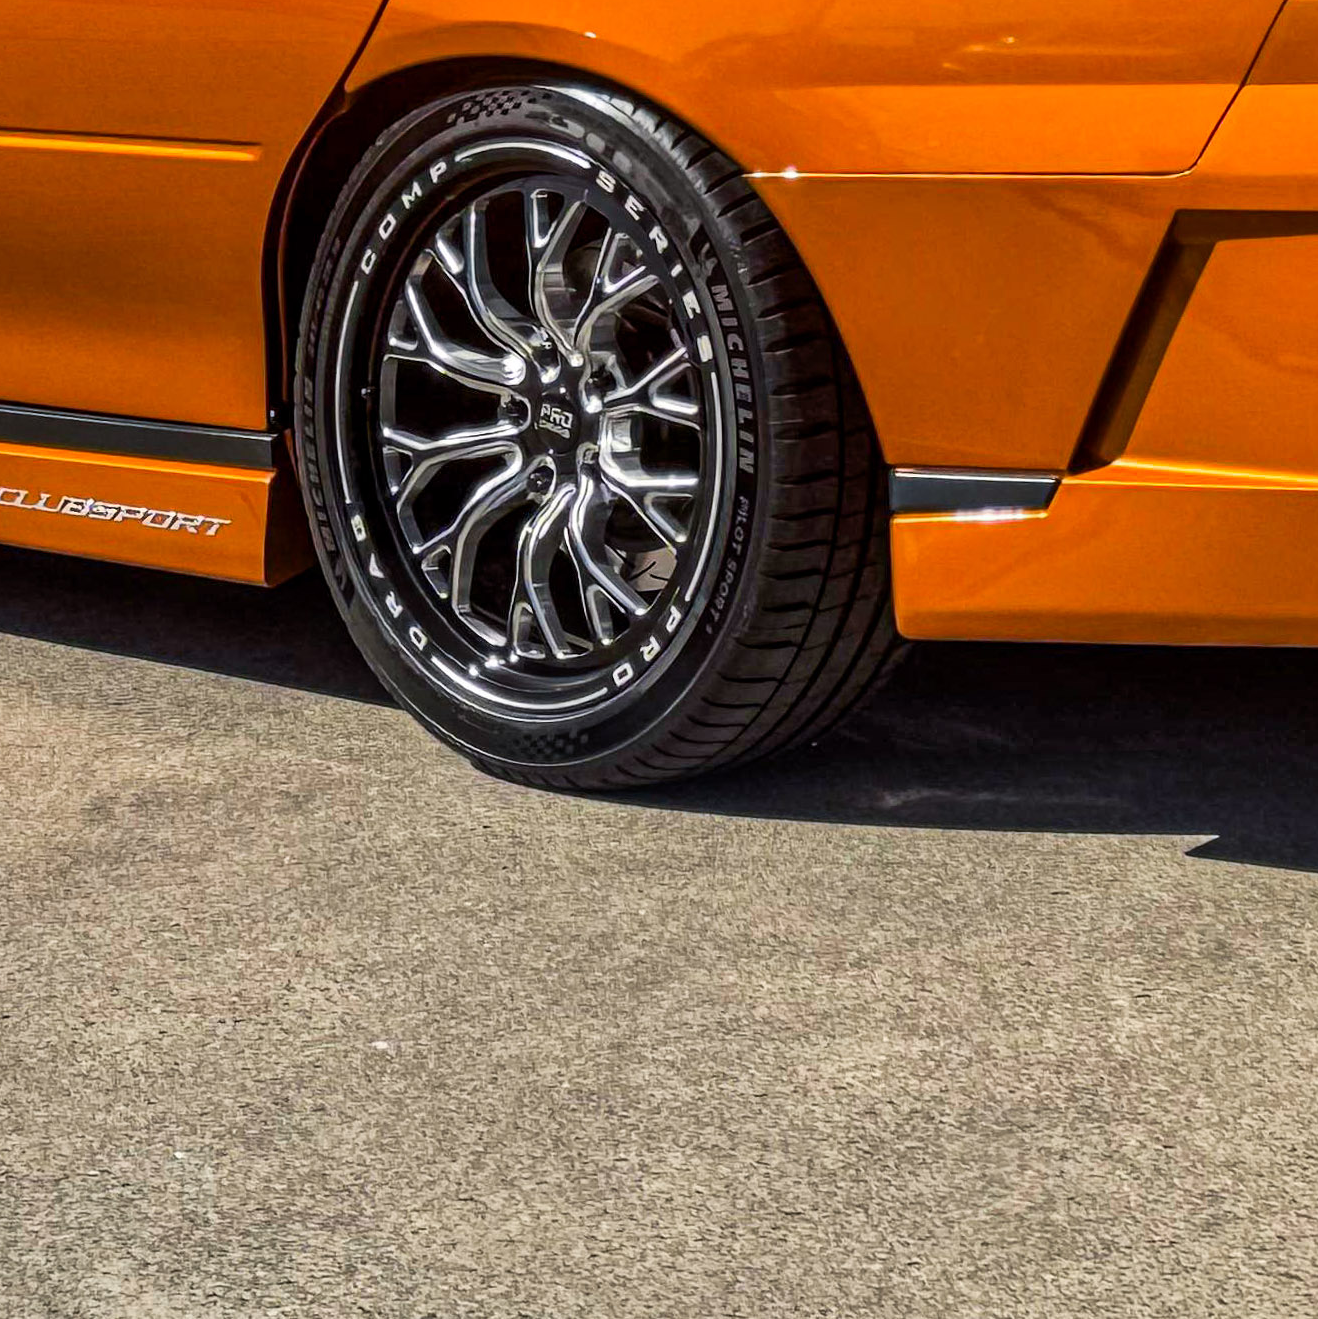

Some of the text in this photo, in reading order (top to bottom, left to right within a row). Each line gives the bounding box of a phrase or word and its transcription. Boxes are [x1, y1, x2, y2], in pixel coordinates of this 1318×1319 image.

[361, 161, 714, 363] COMP SERIES
[711, 284, 755, 475] MICHELIN
[612, 605, 682, 687] PRO
